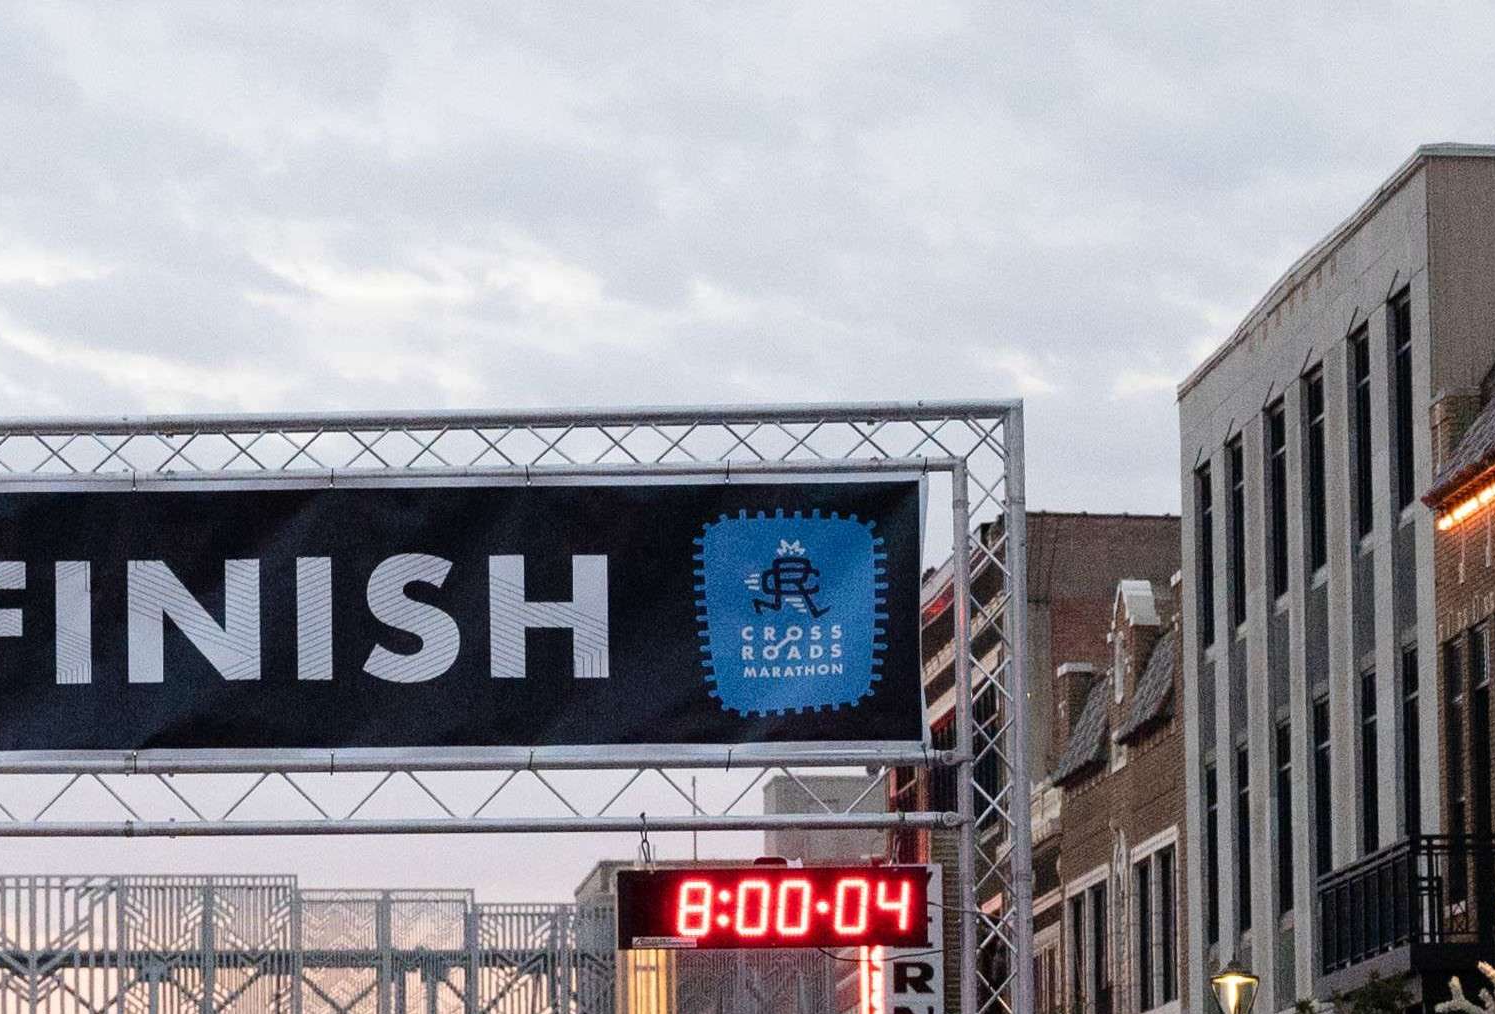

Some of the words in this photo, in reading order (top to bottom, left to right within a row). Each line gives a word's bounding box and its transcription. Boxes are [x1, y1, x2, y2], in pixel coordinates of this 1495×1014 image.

[740, 625, 843, 641] CROSS
[741, 645, 843, 661] ROADS
[743, 663, 844, 679] MARATHON
